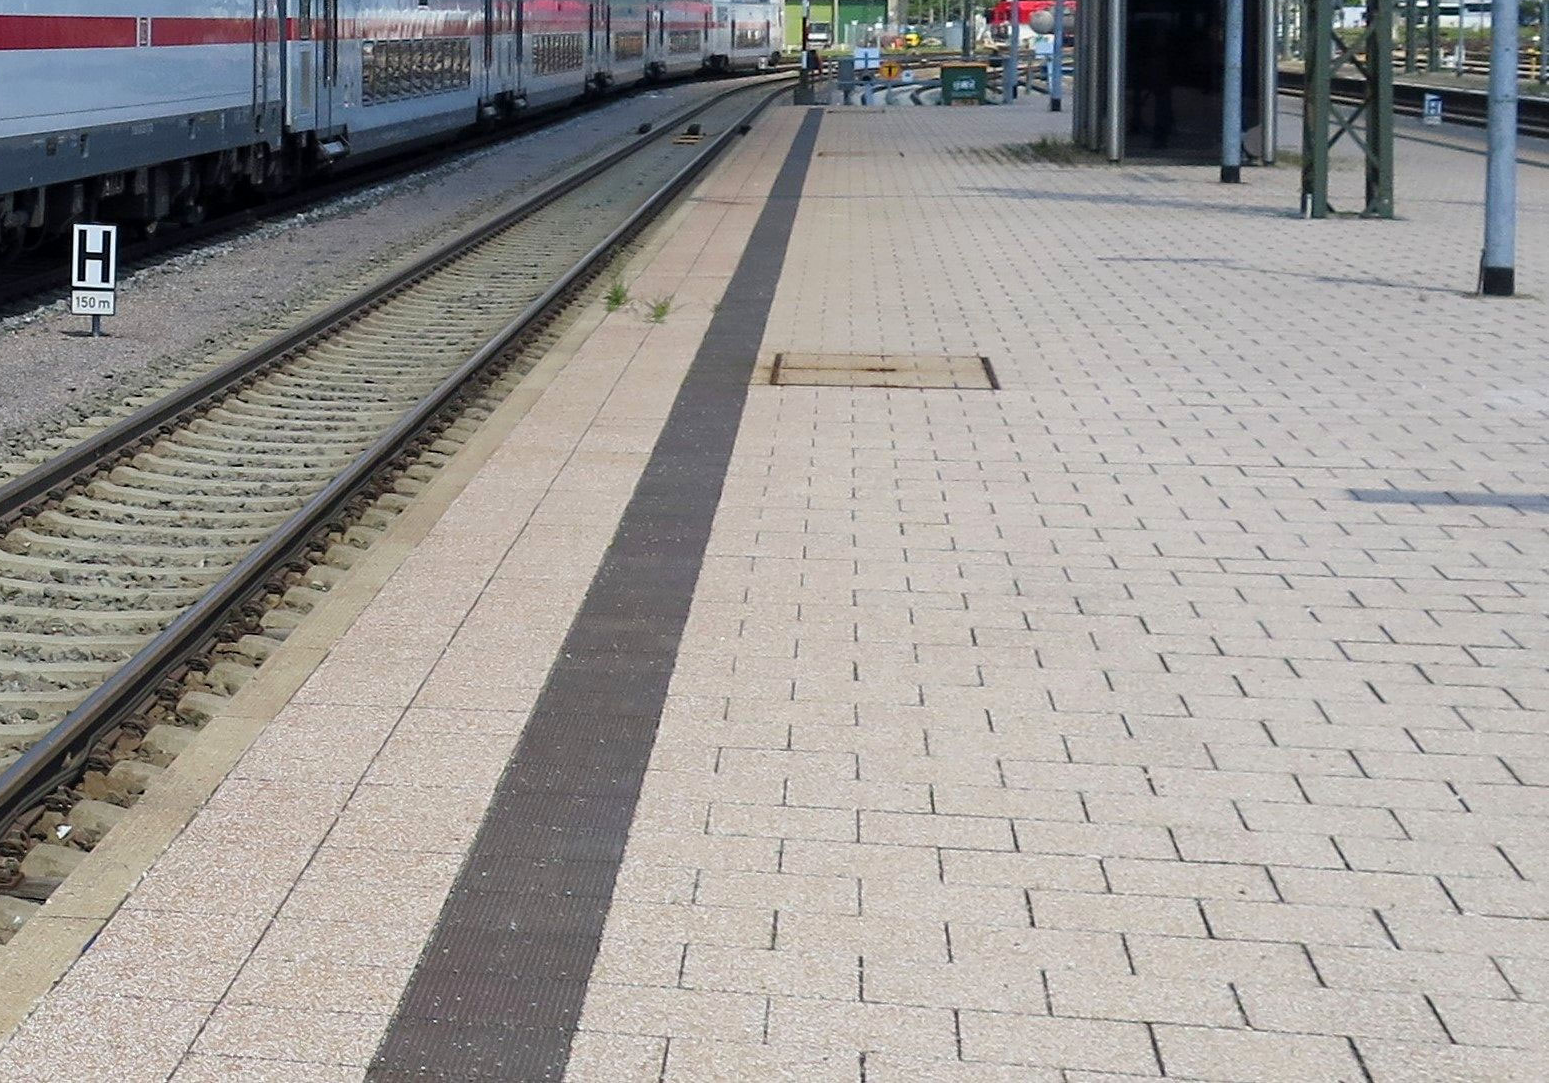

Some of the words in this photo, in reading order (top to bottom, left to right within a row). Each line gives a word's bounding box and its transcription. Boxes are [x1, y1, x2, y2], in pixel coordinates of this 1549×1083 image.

[77, 229, 111, 283] H
[75, 296, 96, 308] 150
[98, 299, 111, 309] m
